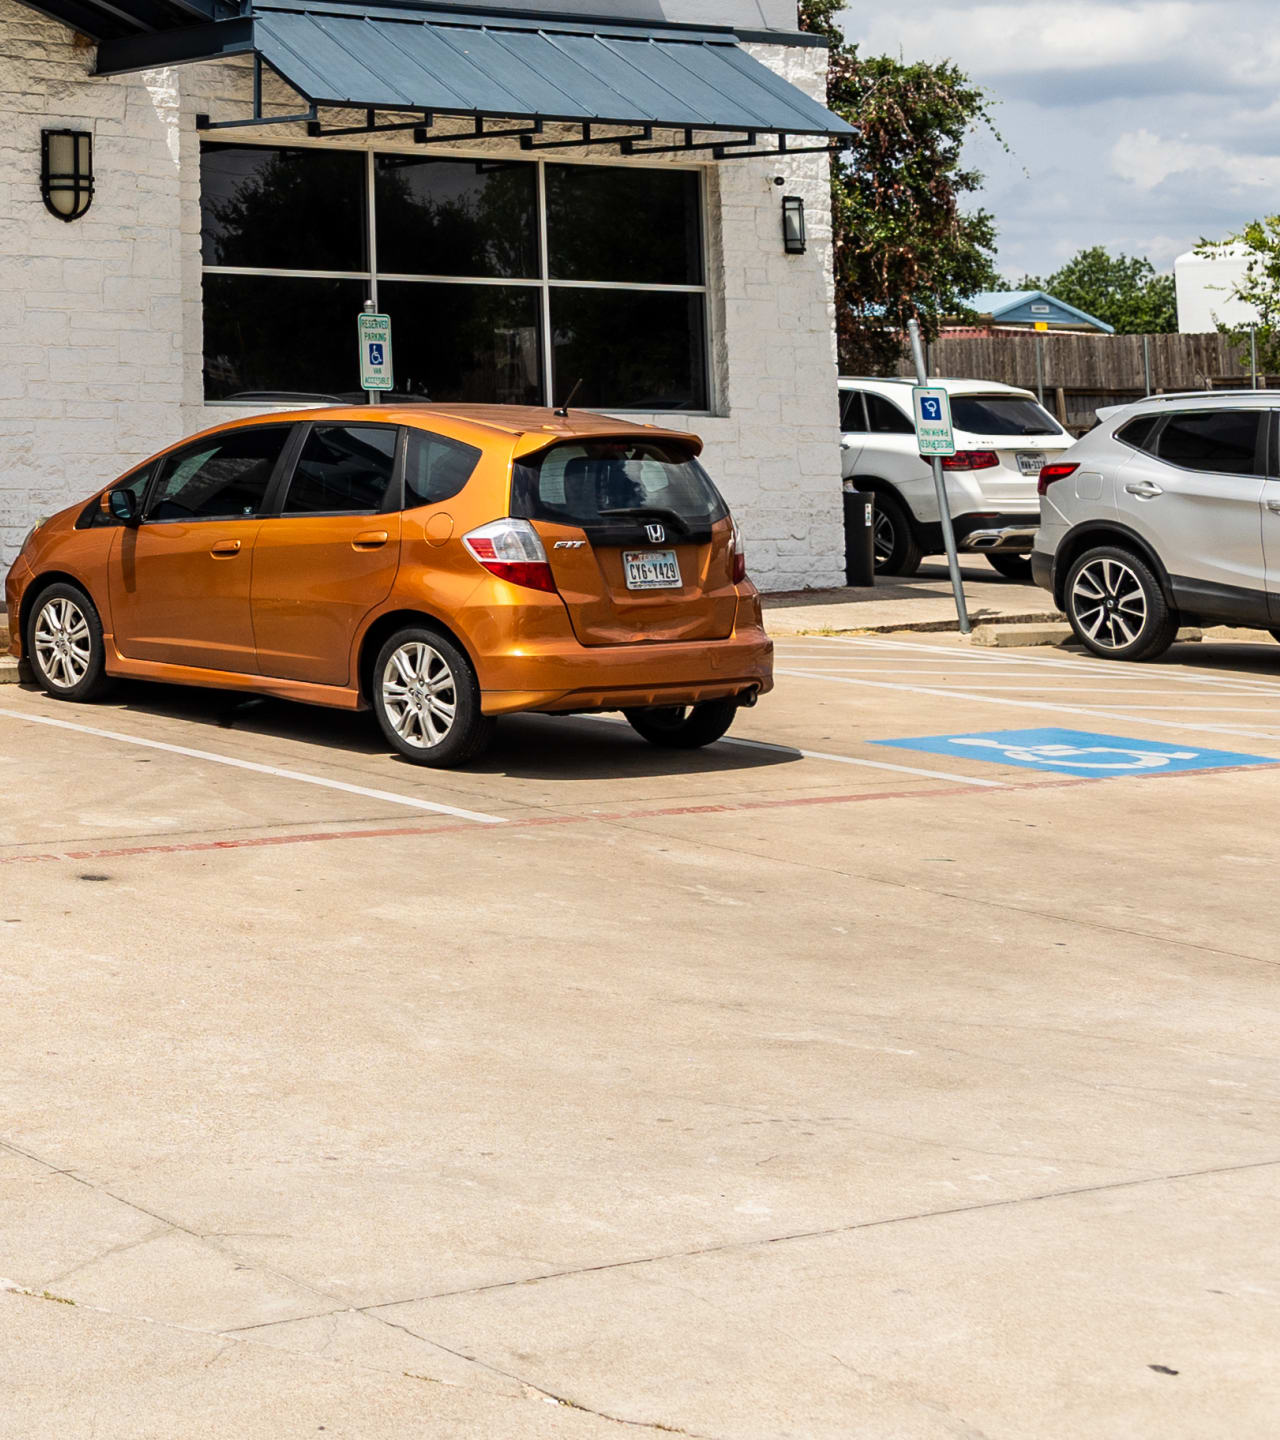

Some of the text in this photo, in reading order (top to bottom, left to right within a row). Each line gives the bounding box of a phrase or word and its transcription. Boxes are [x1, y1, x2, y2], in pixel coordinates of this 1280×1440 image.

[361, 318, 388, 329] RESERVED
[364, 332, 387, 342] PARKING
[553, 541, 586, 549] FIT
